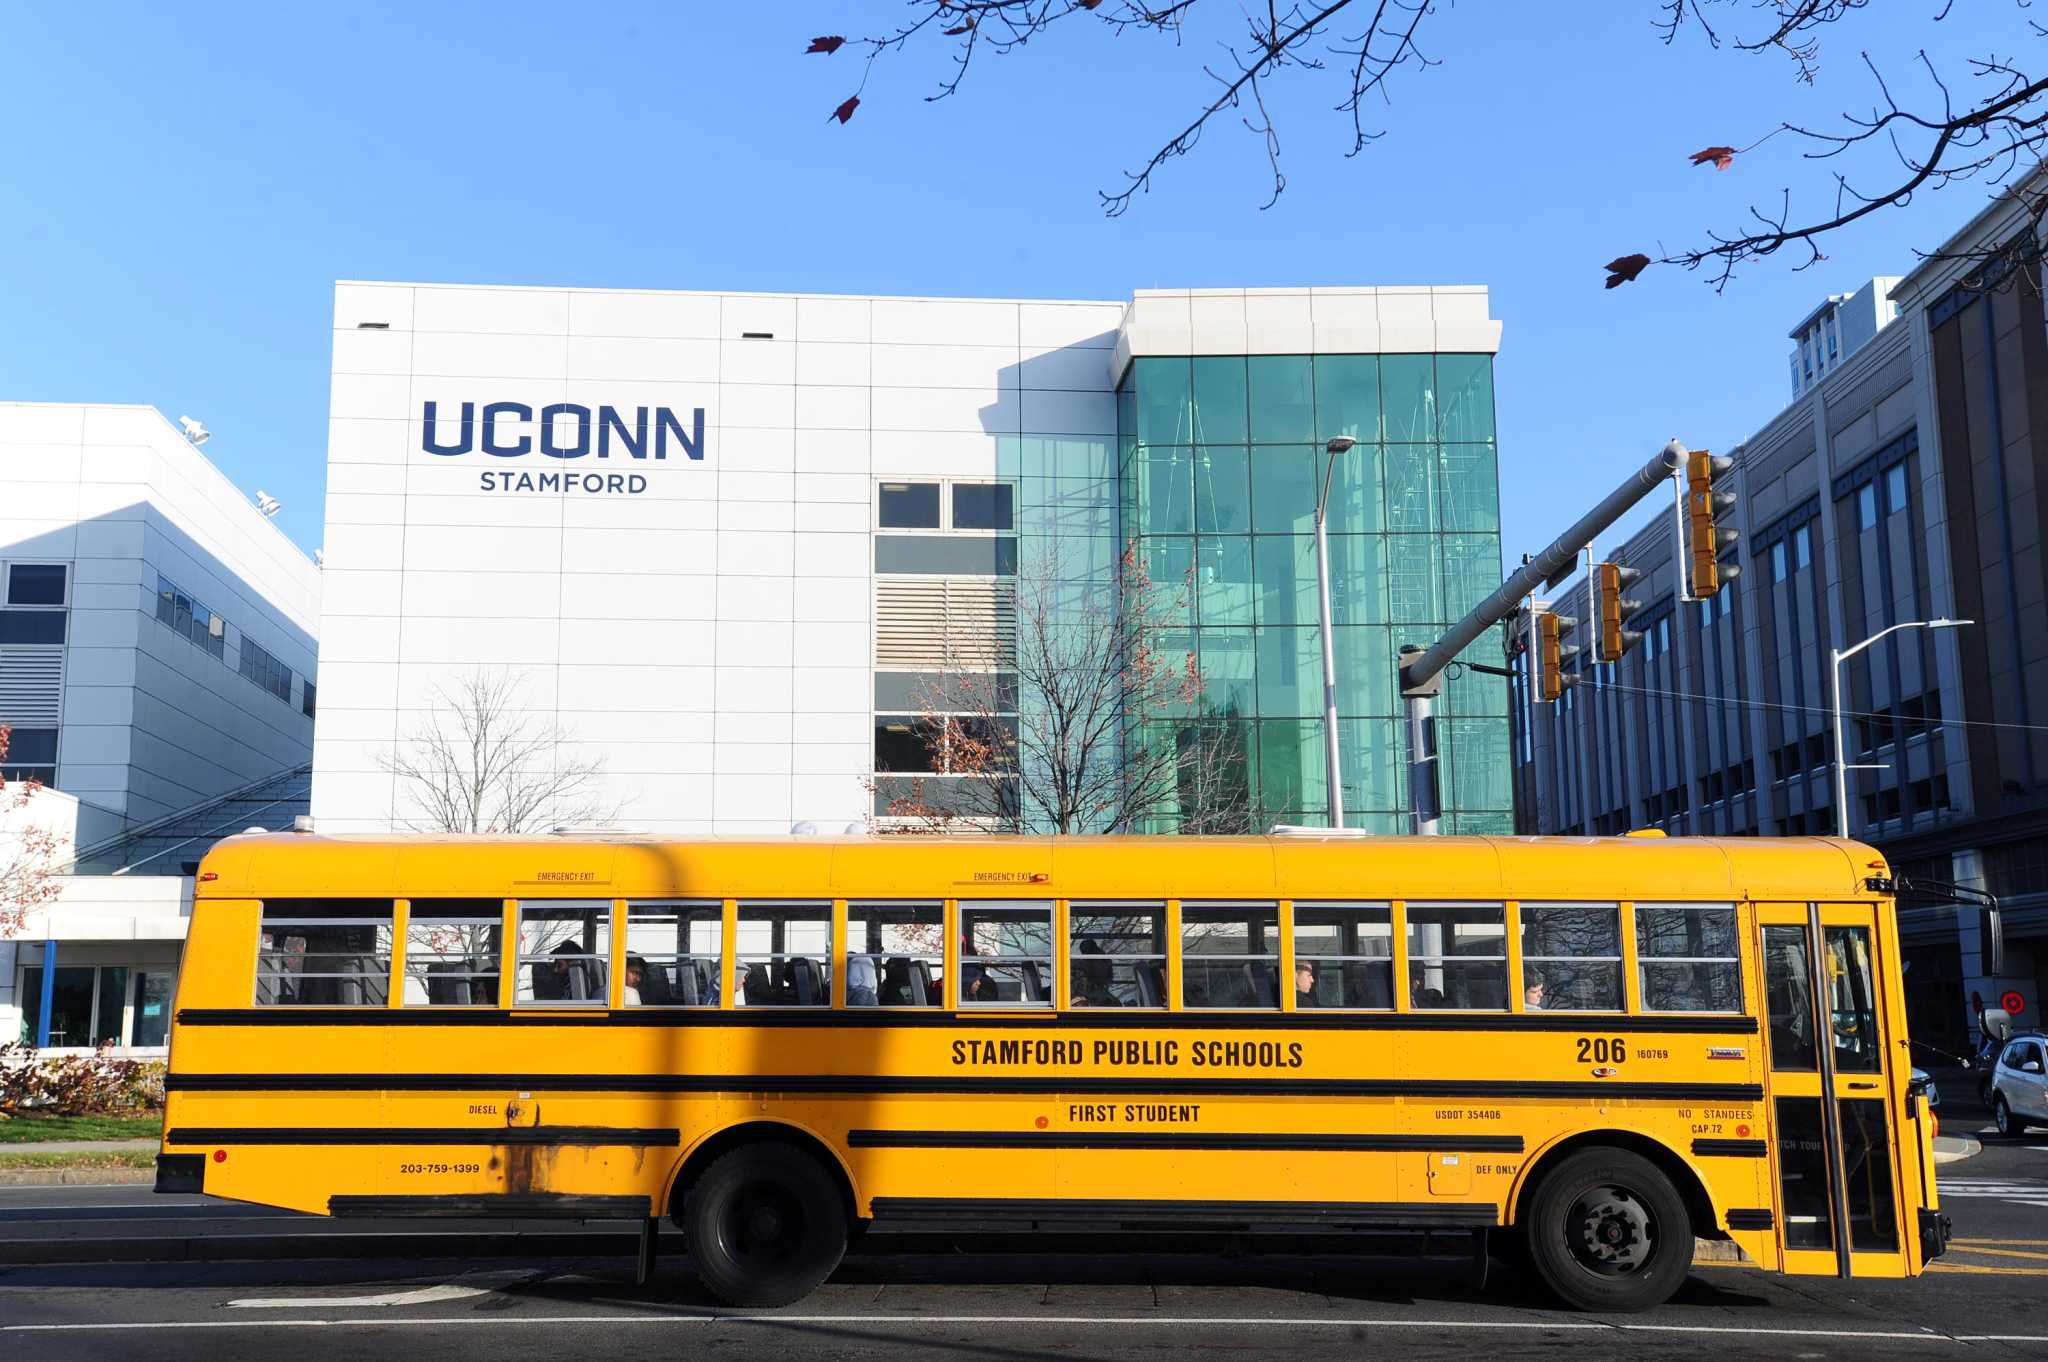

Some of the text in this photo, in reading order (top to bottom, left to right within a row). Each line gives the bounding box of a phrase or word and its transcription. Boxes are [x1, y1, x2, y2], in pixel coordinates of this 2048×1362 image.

[422, 401, 705, 461] UCONN
[480, 472, 647, 494] STAMFORD
[537, 872, 594, 881] EMERGENCY EXIT
[973, 872, 1032, 881] EMERGENCY EXIT
[952, 1040, 1303, 1068] STAMFORD PUBLIC SCHOOLS
[1577, 1038, 1626, 1063] 206
[1637, 1049, 1669, 1059] 160769
[469, 1105, 498, 1115] DIESEL
[1069, 1105, 1200, 1122] FIRST STUDENT
[1435, 1110, 1501, 1120] USDOT 354406
[1678, 1109, 1753, 1120] NO STANDEES
[400, 1164, 480, 1174] 203-759-1399
[1476, 1165, 1518, 1175] DEF ONLY
